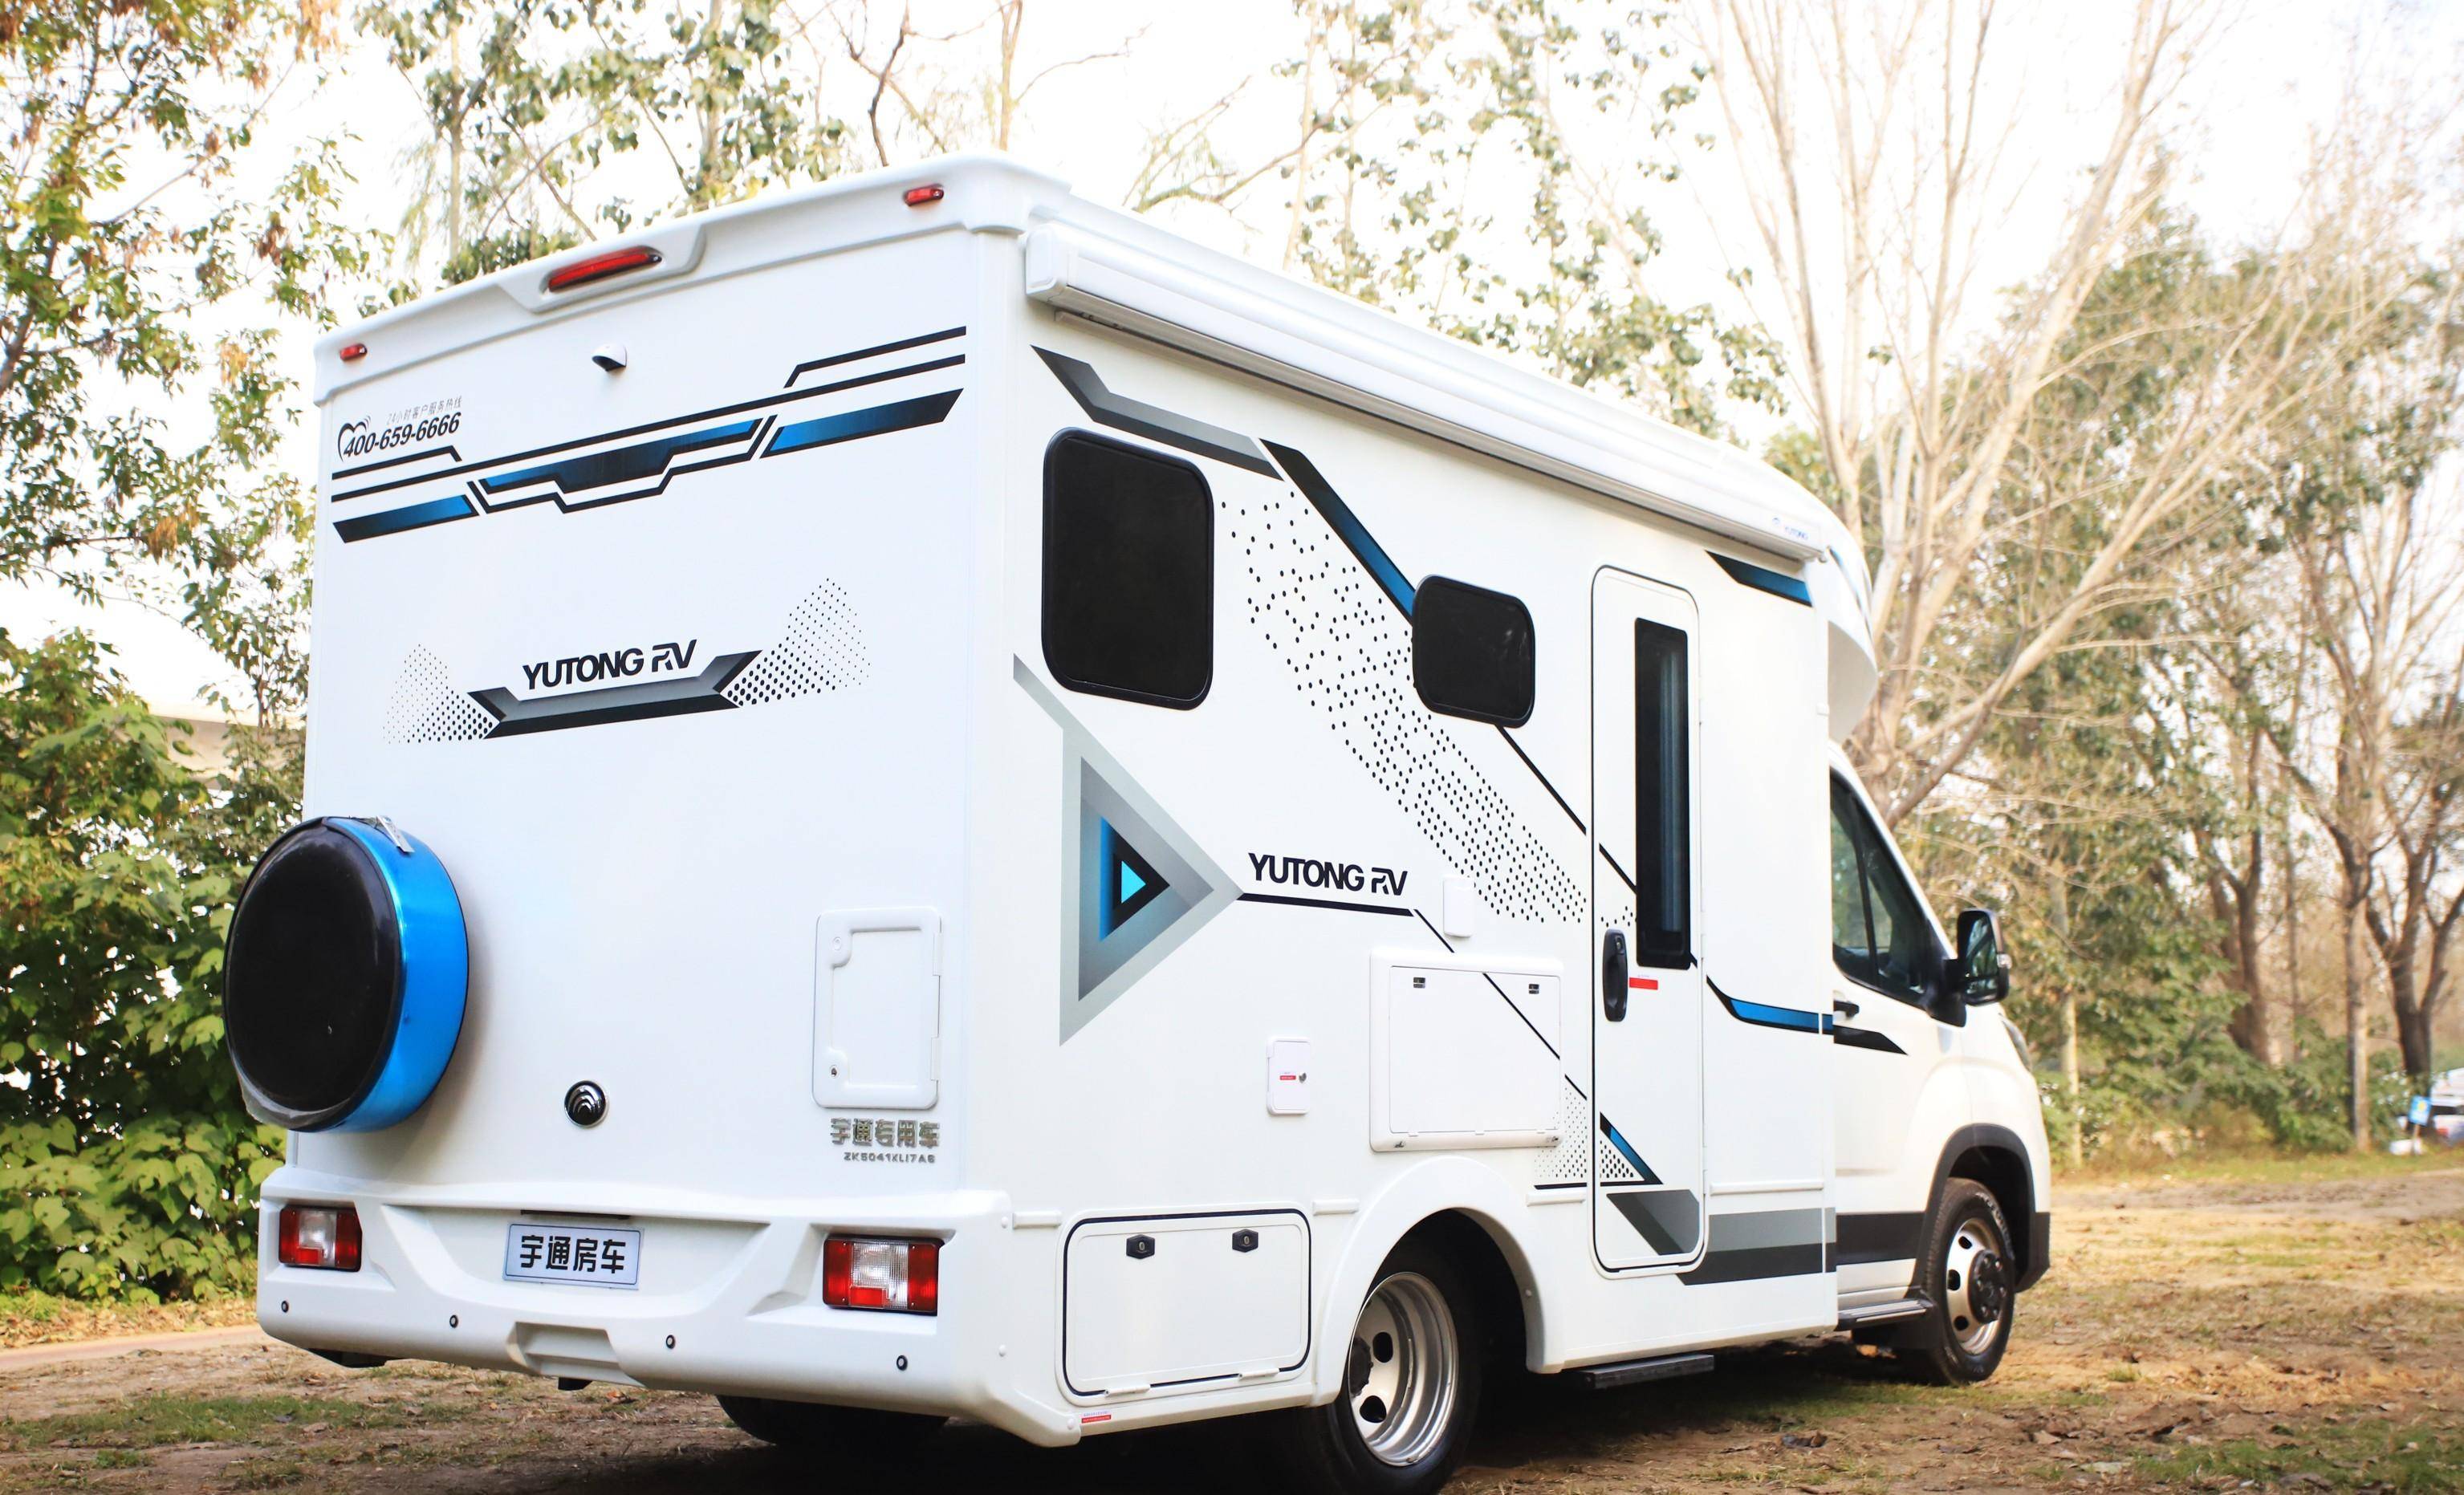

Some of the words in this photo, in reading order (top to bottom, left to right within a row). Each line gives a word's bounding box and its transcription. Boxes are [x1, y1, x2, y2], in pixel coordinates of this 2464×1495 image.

[343, 412, 461, 457] 400-659-6666
[522, 648, 644, 690] YUTONG
[651, 639, 697, 672] RV
[1248, 852, 1365, 892] YUTONG
[1371, 867, 1408, 896] RV
[830, 1117, 940, 1148] 宇通专用车
[519, 1234, 626, 1274] 宇通房车
